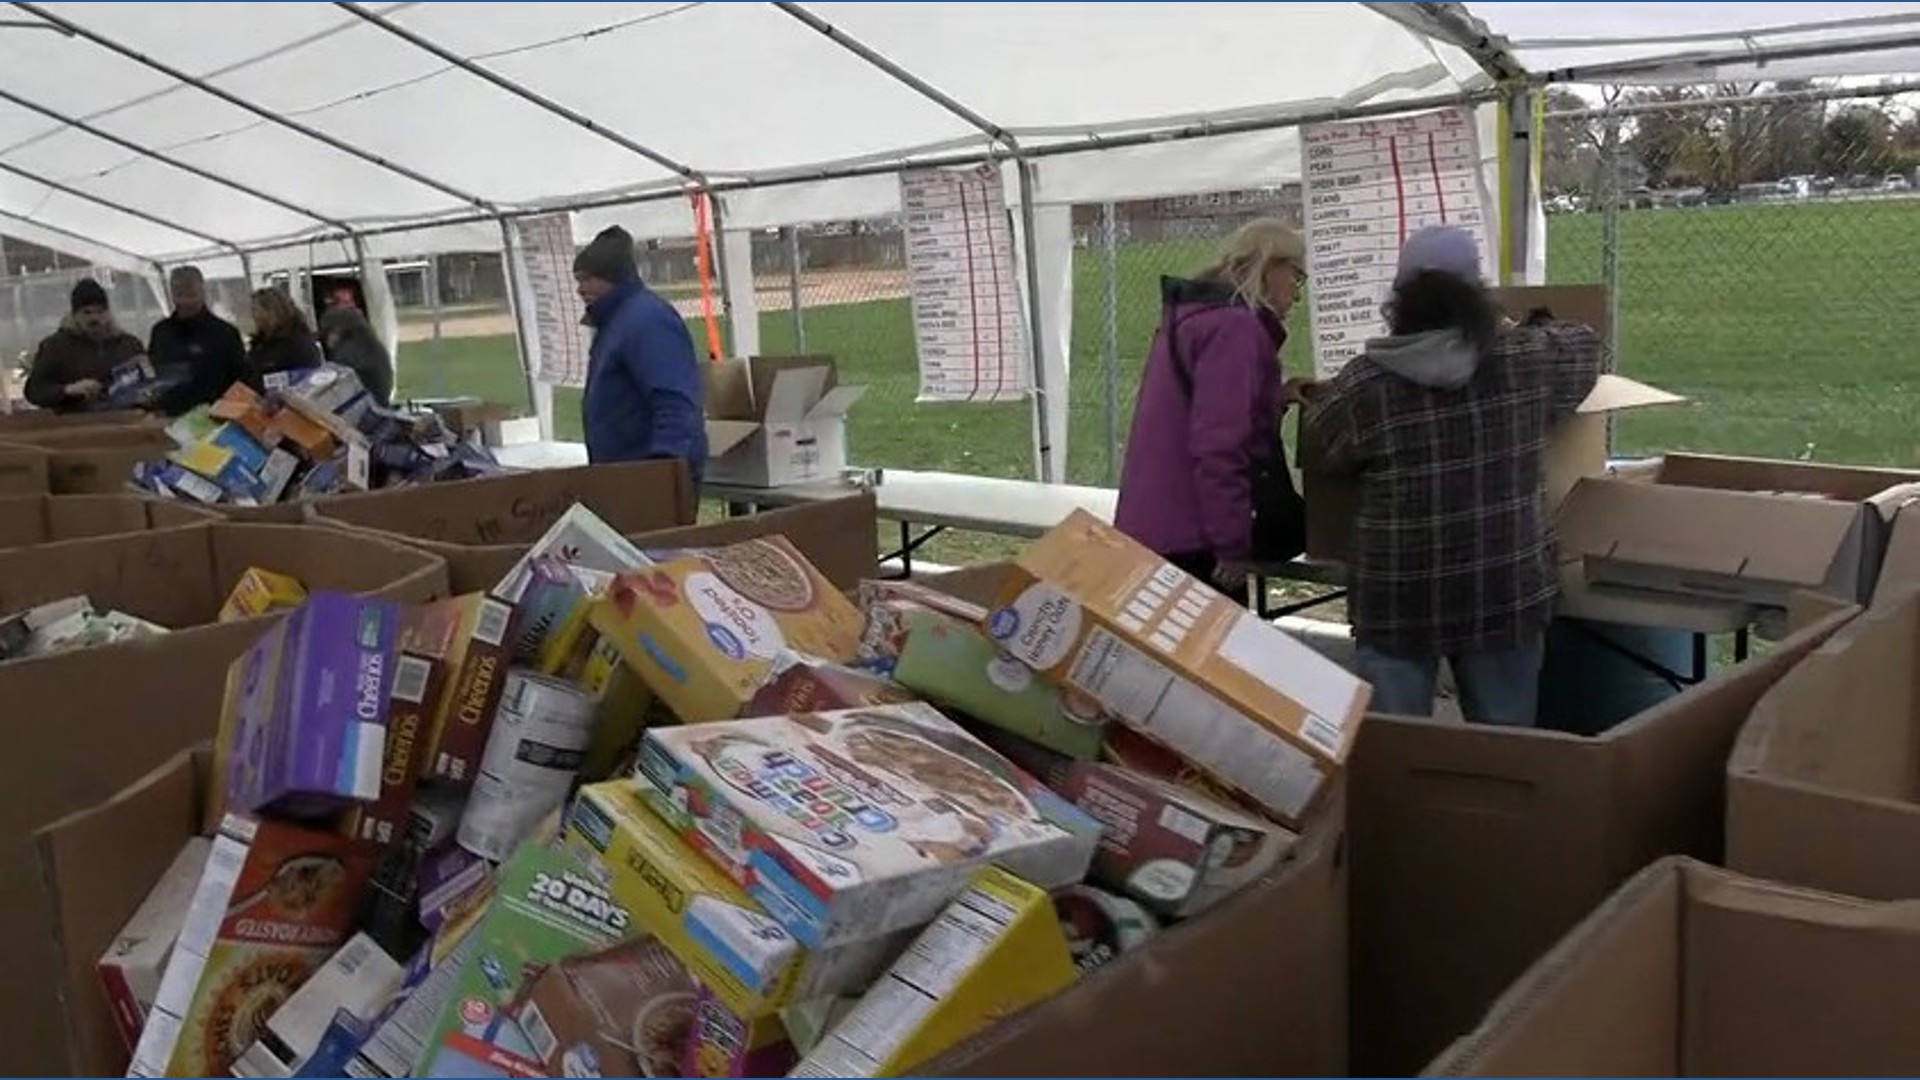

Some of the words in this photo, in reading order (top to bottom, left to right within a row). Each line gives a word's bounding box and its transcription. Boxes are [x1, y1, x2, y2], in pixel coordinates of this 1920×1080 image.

[1320, 330, 1346, 341] SOUP
[358, 653, 383, 718] Cheerios
[460, 655, 497, 724] Cheerios
[384, 713, 419, 785] Cheerios
[761, 750, 898, 833] Crunch
[530, 871, 568, 901] 20
[565, 886, 630, 928] DAYS
